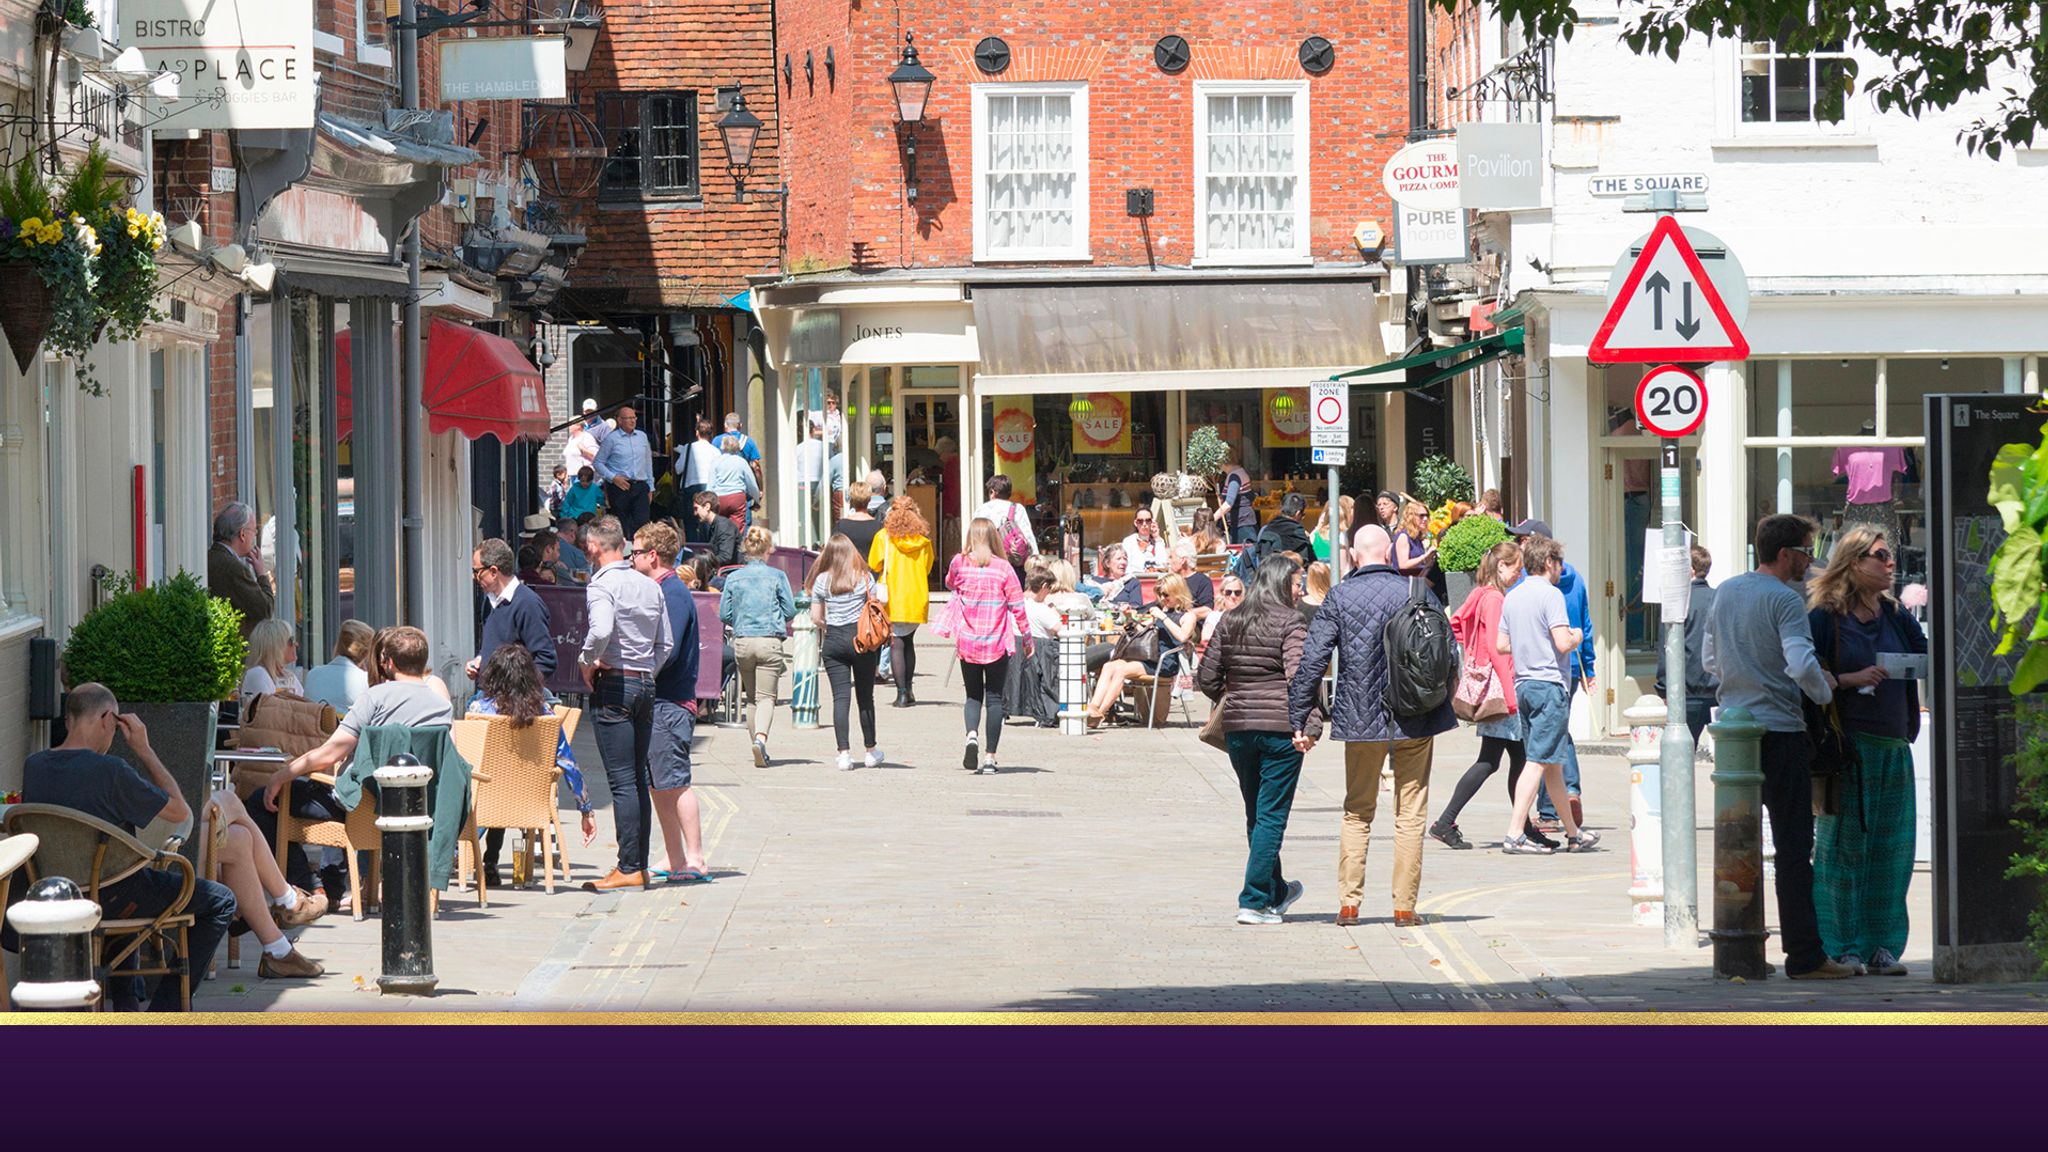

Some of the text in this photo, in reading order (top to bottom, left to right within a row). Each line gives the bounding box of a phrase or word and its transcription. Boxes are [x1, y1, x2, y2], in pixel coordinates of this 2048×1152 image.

[135, 19, 206, 38] BISTRO
[194, 58, 297, 81] PLACE
[444, 79, 561, 95] THE HAMBLEDON
[272, 91, 297, 104] BAR
[1427, 153, 1448, 162] THE
[1392, 163, 1459, 181] GOURM
[1468, 153, 1533, 177] Pavilion
[1399, 182, 1428, 192] PIZZA
[1592, 176, 1704, 192] THE SQUARE
[1407, 211, 1457, 226] PURE
[1407, 228, 1457, 242] home
[1318, 388, 1340, 396] ZONE
[1648, 385, 1698, 416] 20
[1974, 409, 2020, 421] The Square
[1085, 419, 1120, 430] SALE
[999, 433, 1029, 443] SALE
[1422, 427, 1439, 457] urb
[1666, 451, 1675, 465] 1
